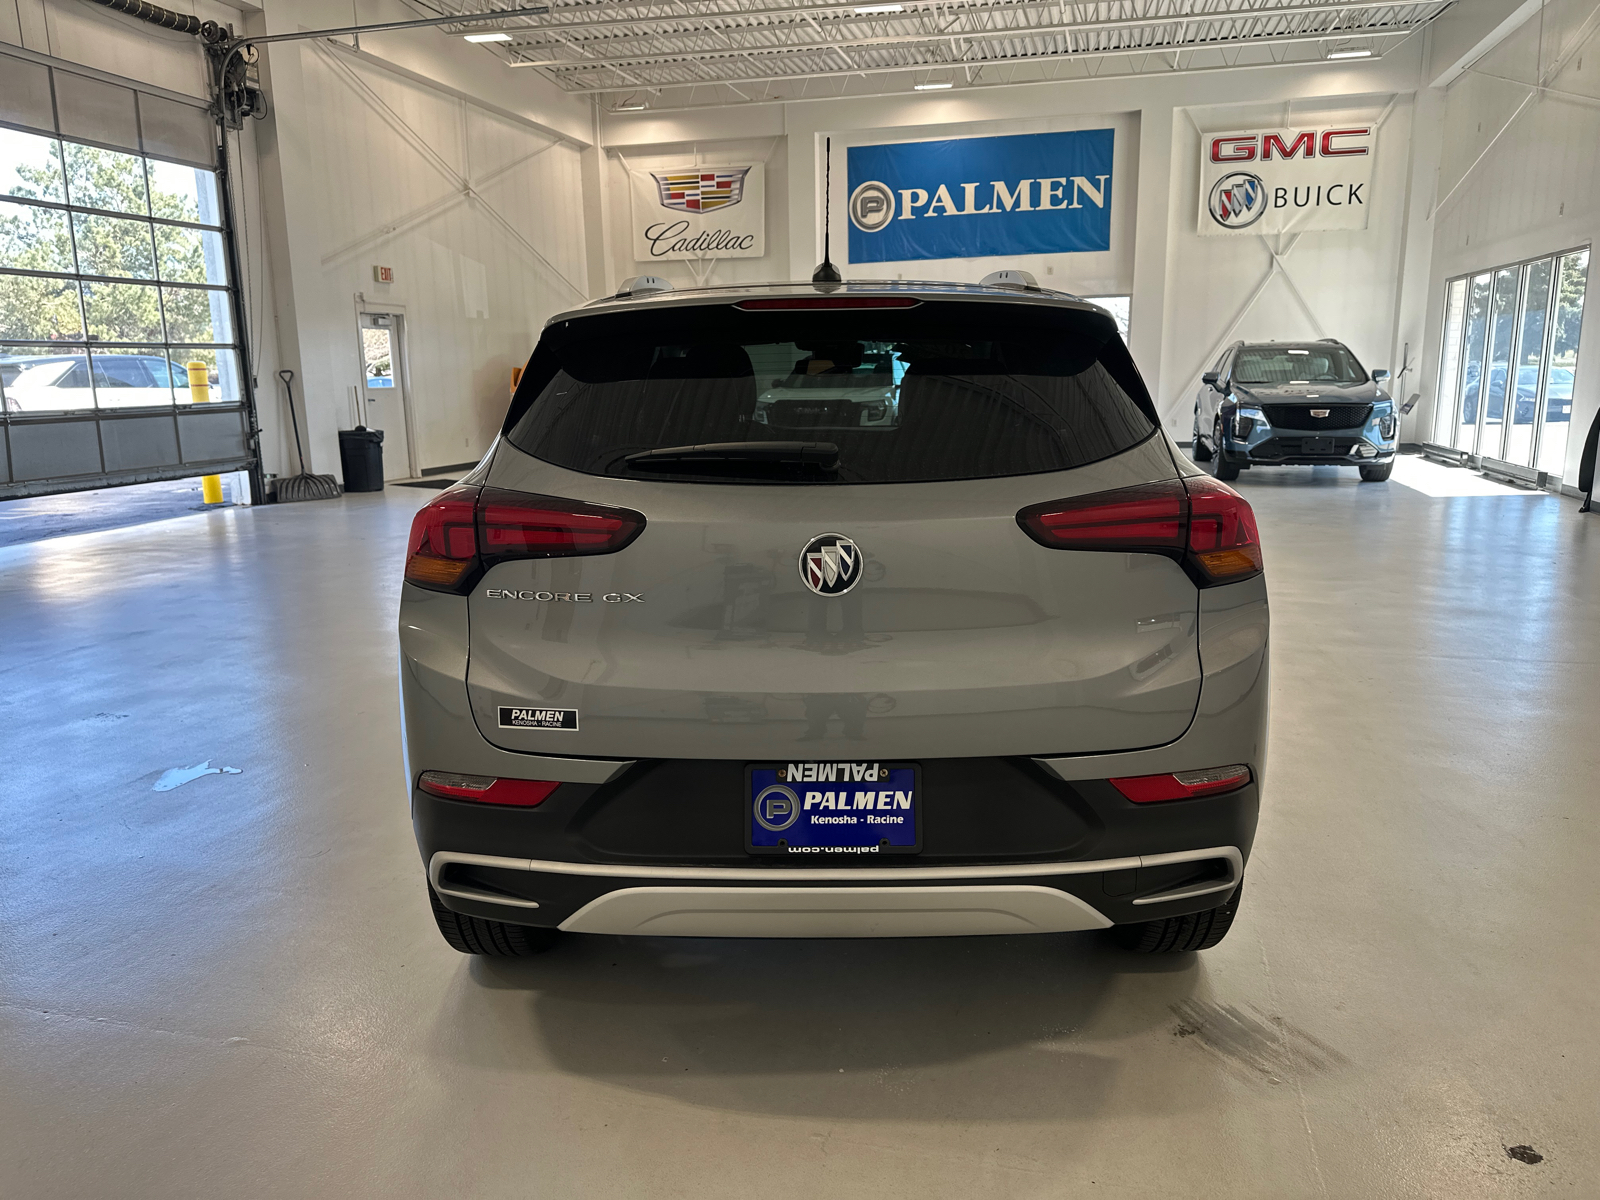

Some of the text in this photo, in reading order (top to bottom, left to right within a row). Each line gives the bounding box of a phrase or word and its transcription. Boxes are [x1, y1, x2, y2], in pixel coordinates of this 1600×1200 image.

[1210, 127, 1371, 164] GMC
[897, 175, 1110, 220] PALMEN
[1274, 183, 1364, 208] BUICK
[644, 220, 754, 256] Cadillac
[380, 266, 391, 281] EXIT
[486, 589, 645, 603] ENCORE GX
[511, 709, 564, 721] PALMEN
[787, 763, 879, 782] PALMEN
[803, 791, 912, 810] PALMEN
[811, 815, 857, 824] Kenosha
[867, 815, 904, 824] Racine
[788, 845, 879, 854] palmen.com
